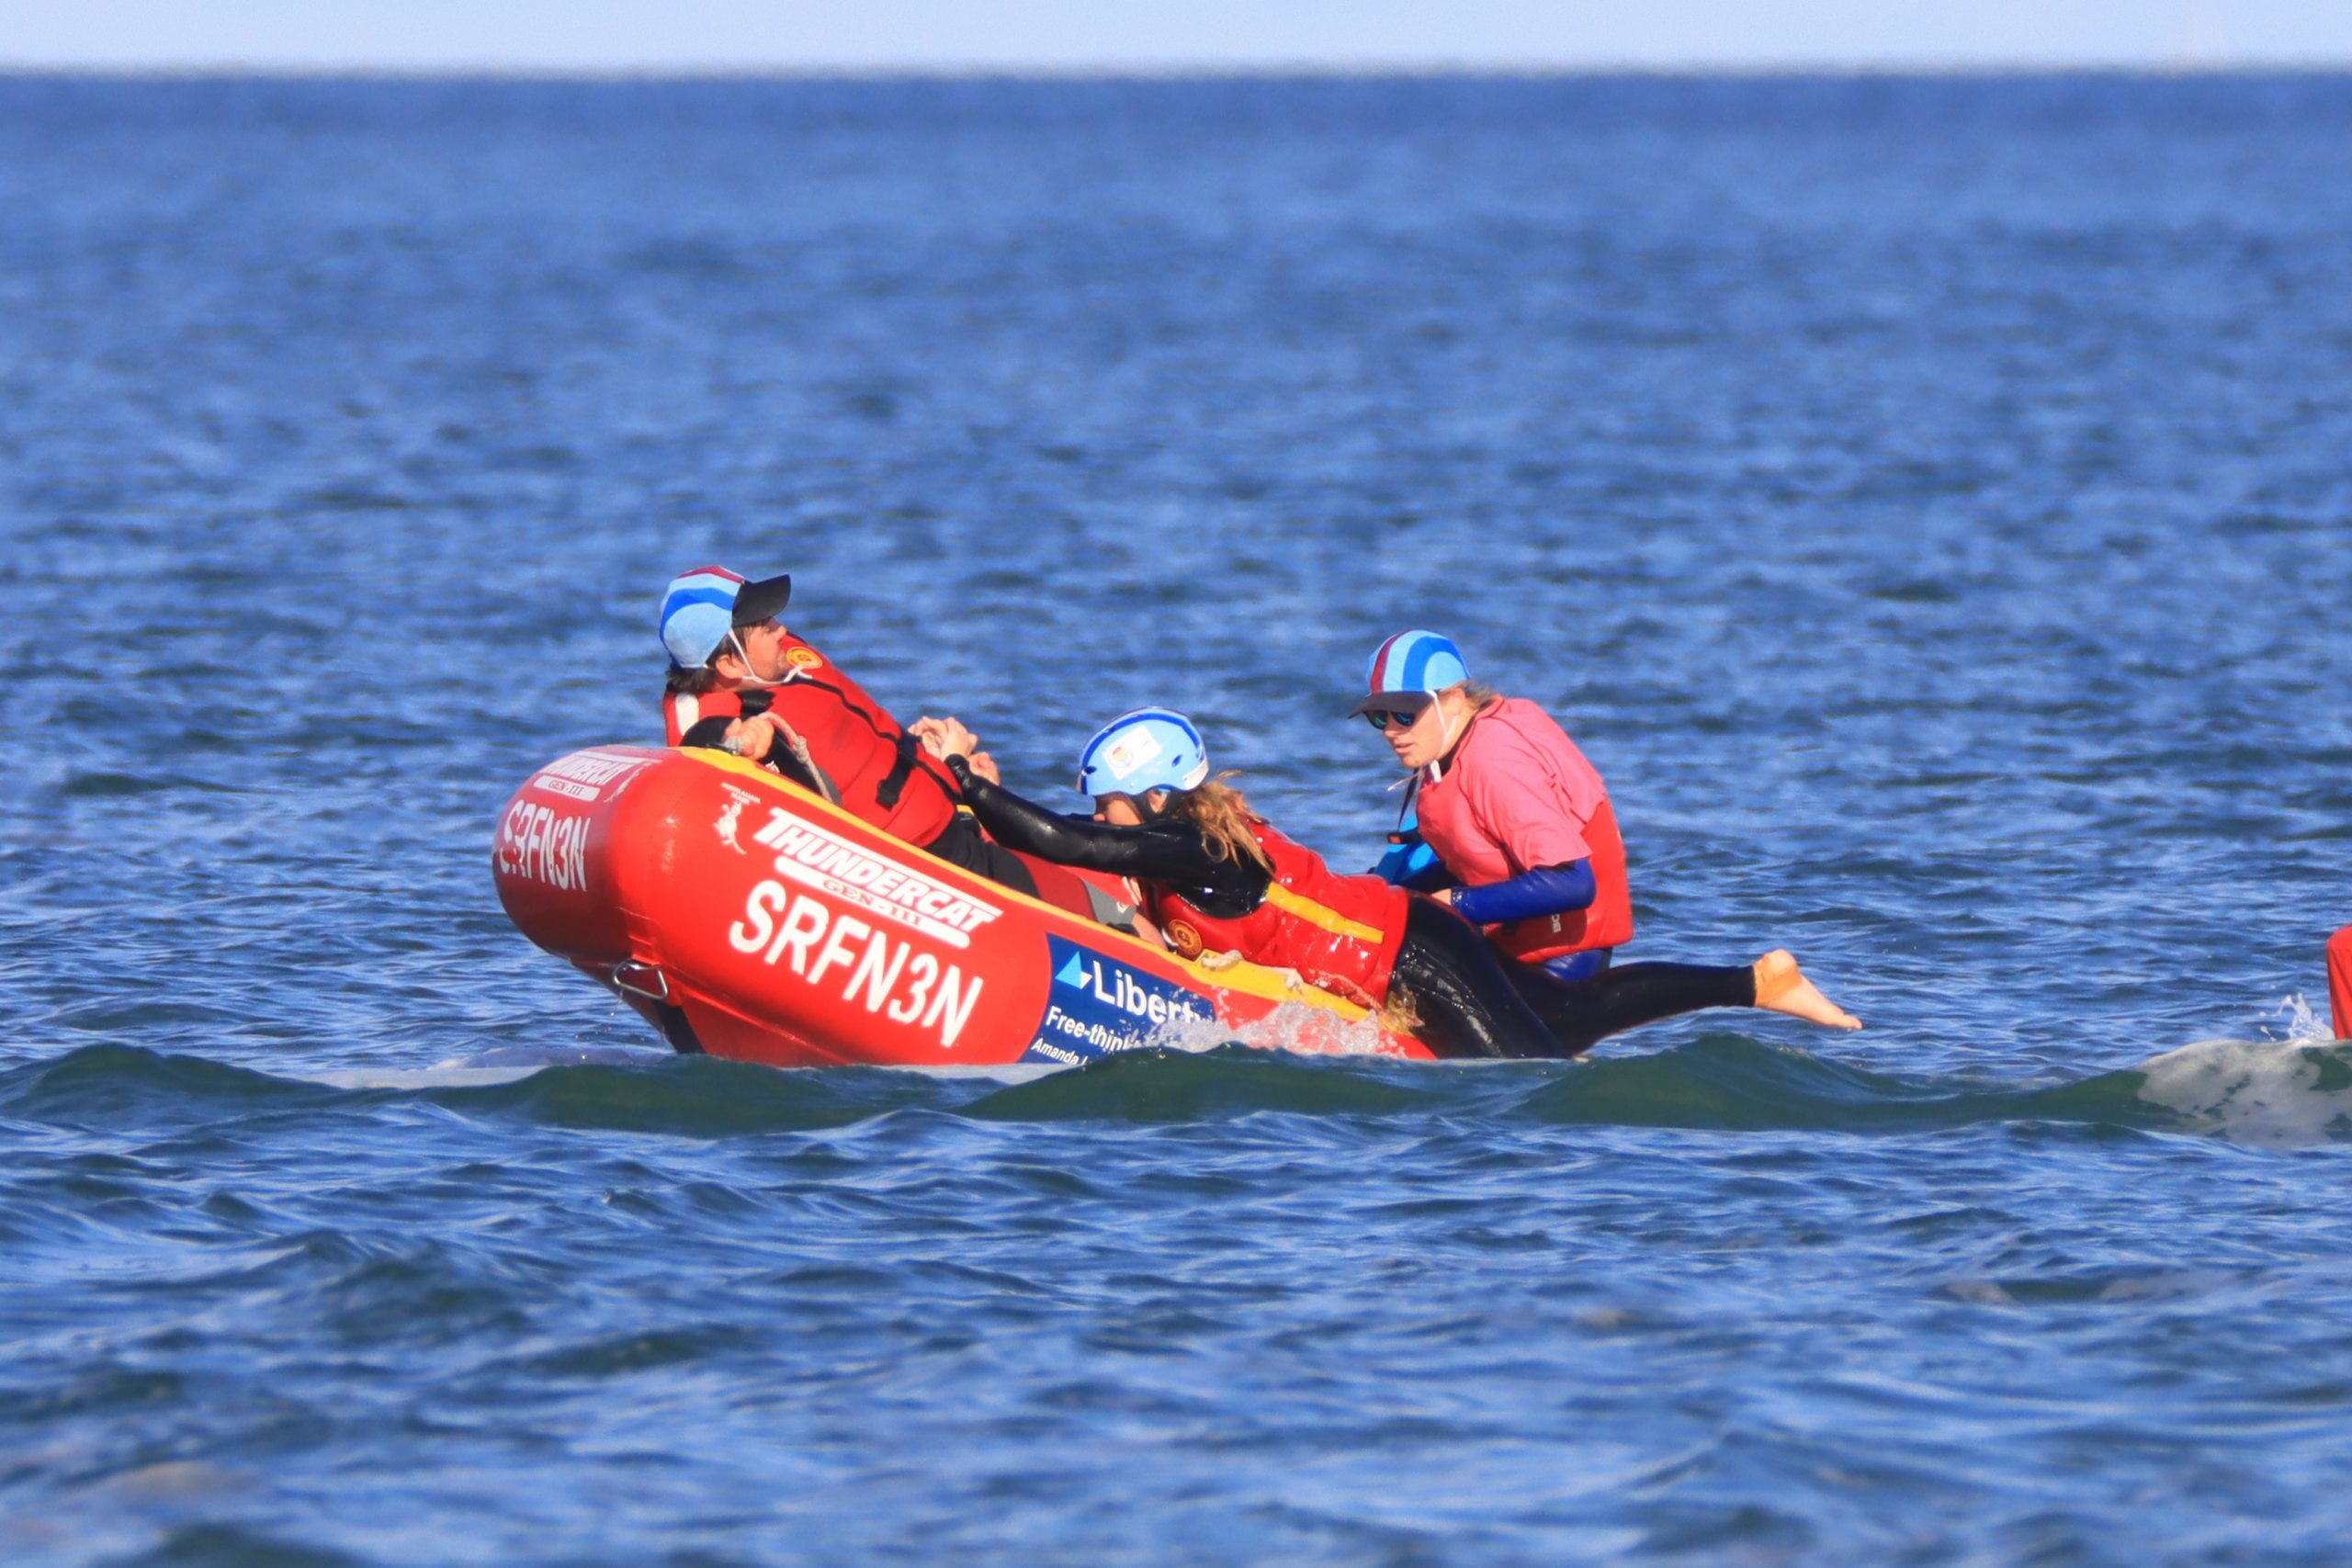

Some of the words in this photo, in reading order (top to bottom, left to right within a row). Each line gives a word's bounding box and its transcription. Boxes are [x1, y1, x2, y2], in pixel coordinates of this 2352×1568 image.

[499, 798, 591, 892] SRFN3N
[752, 807, 1004, 932] THUNDERCAT
[729, 879, 984, 1048] SRFN3N
[1092, 960, 1203, 1025] Libert
[1031, 1037, 1080, 1066] Amanda
